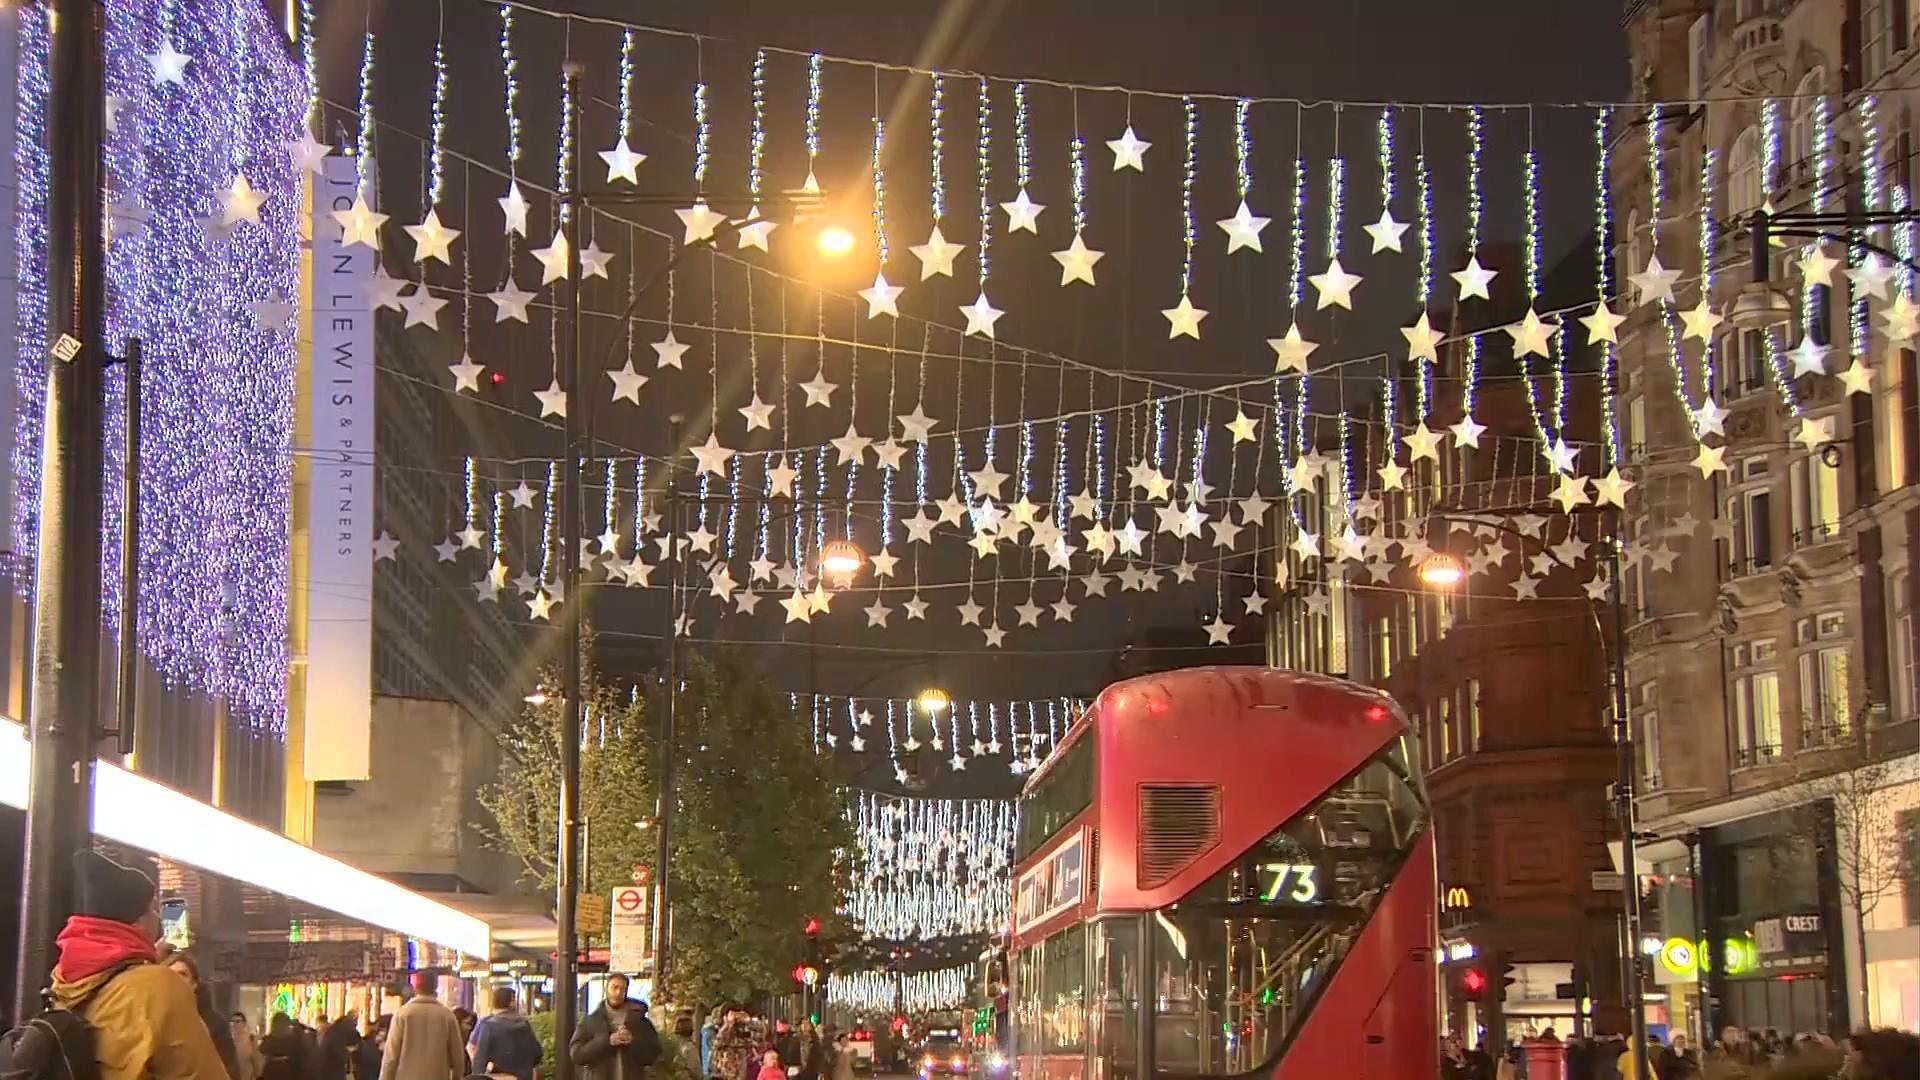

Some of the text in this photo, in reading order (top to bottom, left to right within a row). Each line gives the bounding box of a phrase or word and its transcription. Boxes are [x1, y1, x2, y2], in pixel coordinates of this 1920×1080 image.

[57, 339, 78, 358] 172
[332, 295, 353, 406] LEWIS
[340, 418, 353, 428] &
[338, 439, 353, 556] PARTNERS
[1266, 863, 1317, 902] 73
[1785, 916, 1819, 932] CREST
